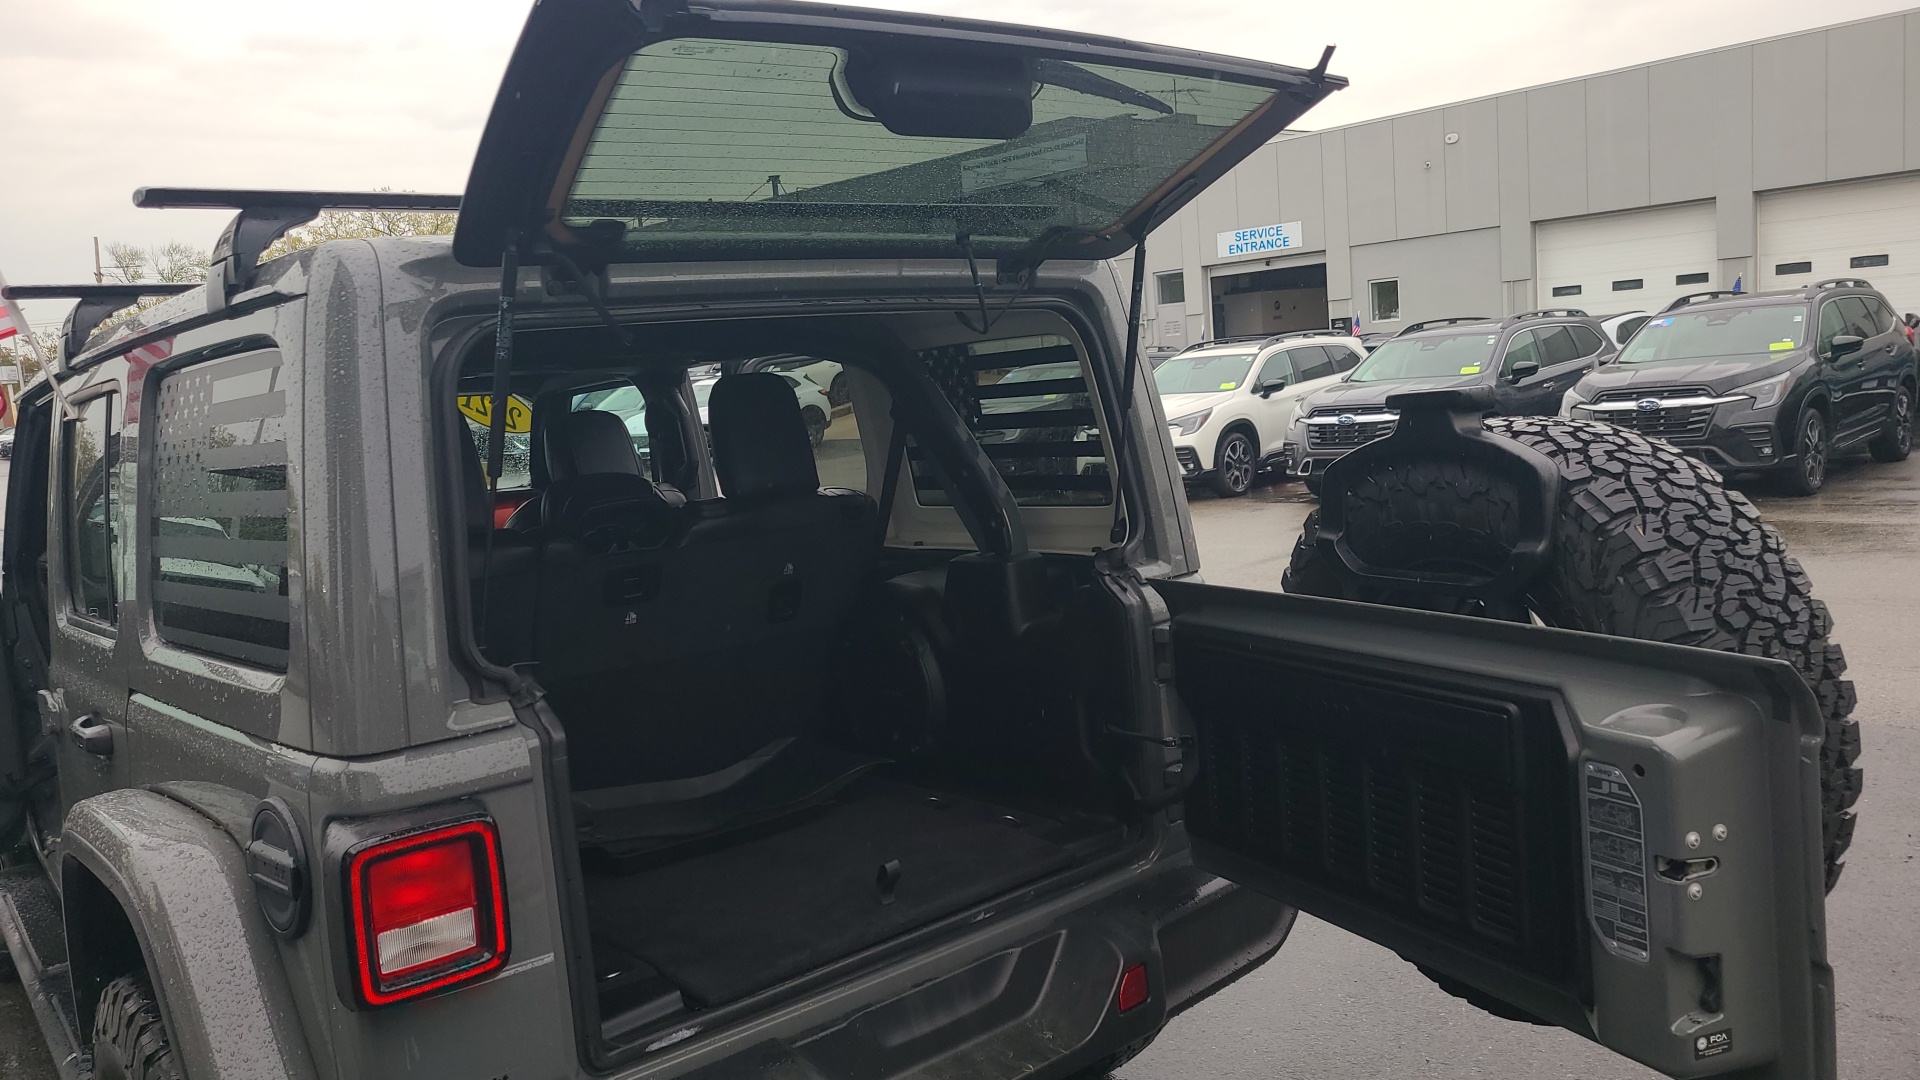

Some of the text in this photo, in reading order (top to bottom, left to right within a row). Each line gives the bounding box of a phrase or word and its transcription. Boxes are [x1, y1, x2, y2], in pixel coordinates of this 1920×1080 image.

[1235, 226, 1283, 242] SERVICE
[1229, 237, 1290, 254] ENTRANCE
[1594, 767, 1612, 777] Jeep
[1589, 780, 1632, 797] JL
[1710, 1033, 1728, 1043] FCA
